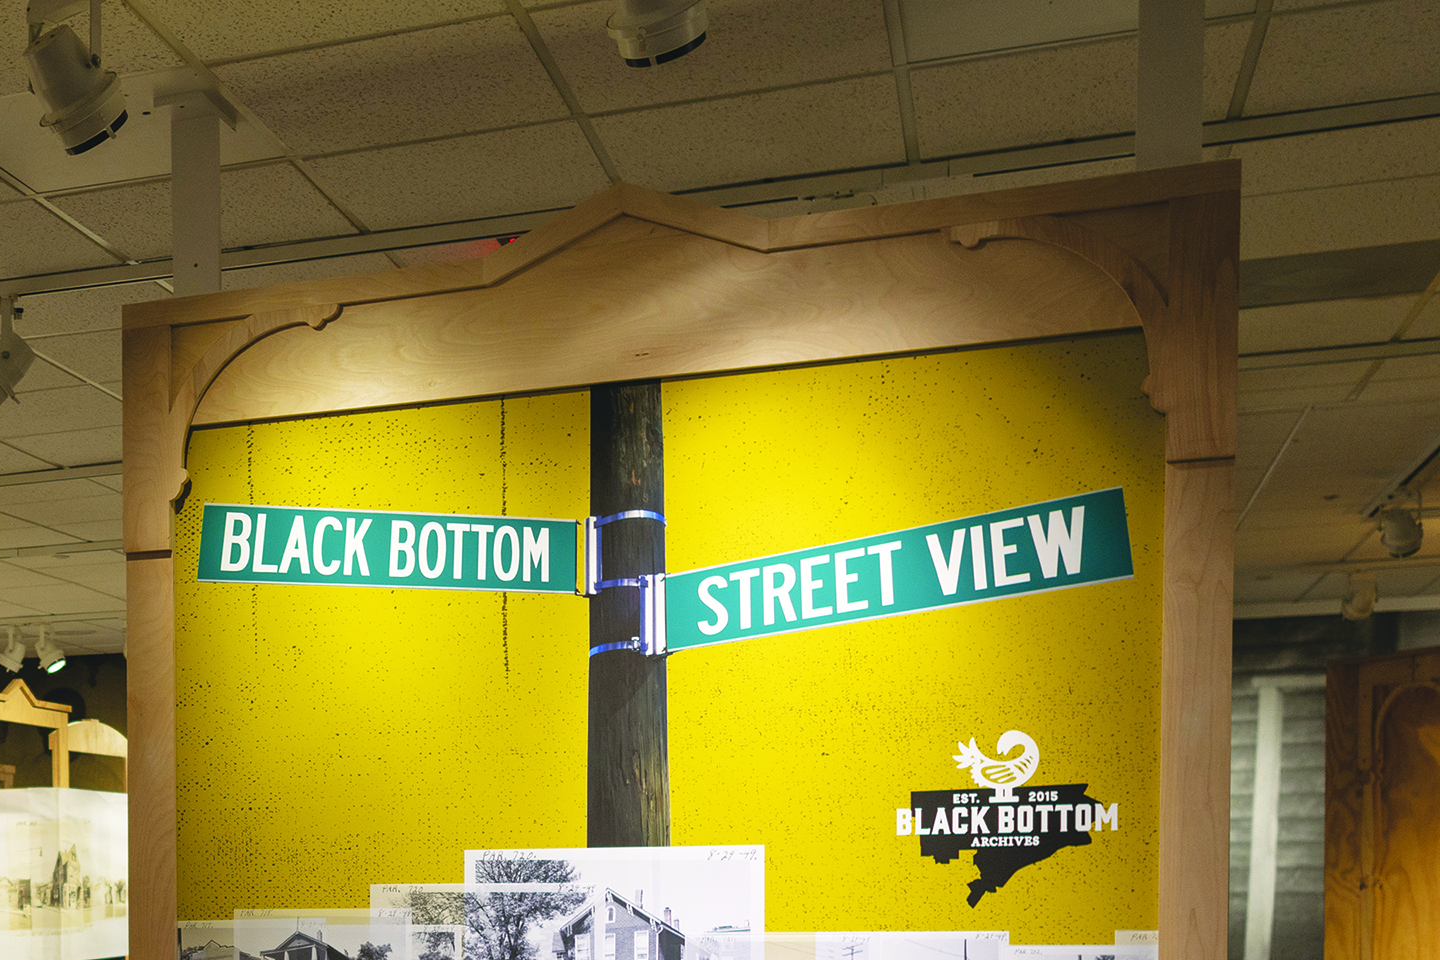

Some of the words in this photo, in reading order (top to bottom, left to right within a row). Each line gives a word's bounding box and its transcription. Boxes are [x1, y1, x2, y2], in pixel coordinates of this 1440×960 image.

[219, 512, 373, 577] BLACK
[388, 519, 551, 584] BOTTOM
[696, 540, 903, 637] STREET
[925, 504, 1087, 597] VIEW
[952, 793, 981, 805] EST.
[1028, 791, 1059, 803] 2015
[896, 806, 991, 836] BLACK
[997, 802, 1119, 834] BOTTOM
[970, 835, 1041, 848] ARCHIVES
